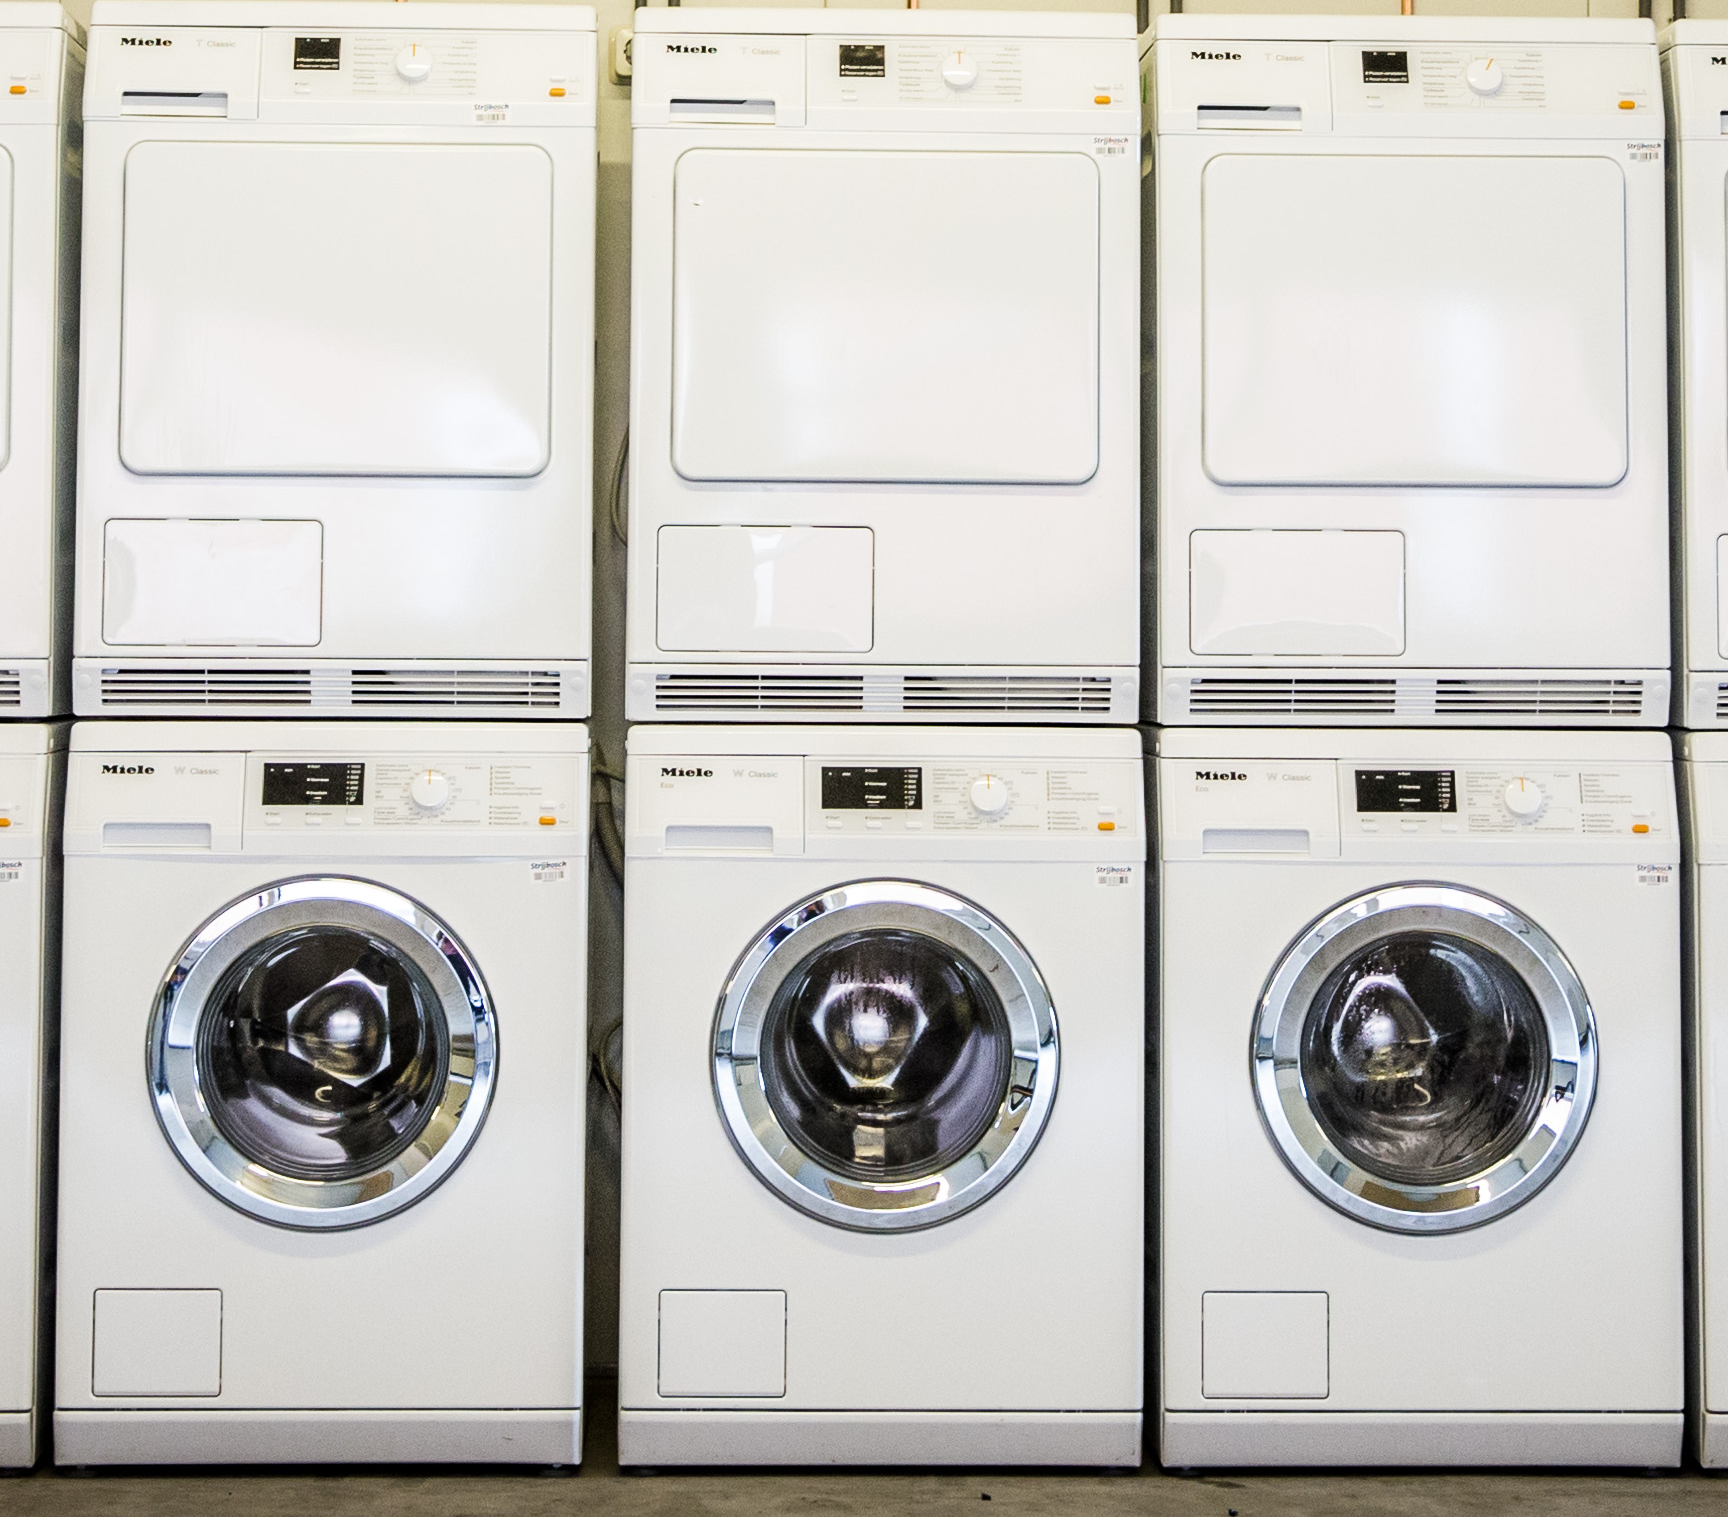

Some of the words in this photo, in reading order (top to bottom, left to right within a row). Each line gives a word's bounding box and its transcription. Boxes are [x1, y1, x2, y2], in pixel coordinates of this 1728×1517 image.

[120, 37, 173, 47] Miele
[206, 40, 236, 48] Classic
[666, 44, 718, 54] Miele
[750, 47, 781, 56] Classic
[1190, 51, 1242, 61] Miele
[1274, 54, 1305, 62] Classic
[101, 764, 155, 775] Miele
[189, 767, 219, 775] Classic
[660, 767, 714, 778] Miele
[747, 770, 778, 779] Classic
[1195, 770, 1248, 781] Miele
[1281, 773, 1312, 782] Classic
[1096, 866, 1132, 874] Strijbosch
[1637, 865, 1672, 873] Strijbosch
